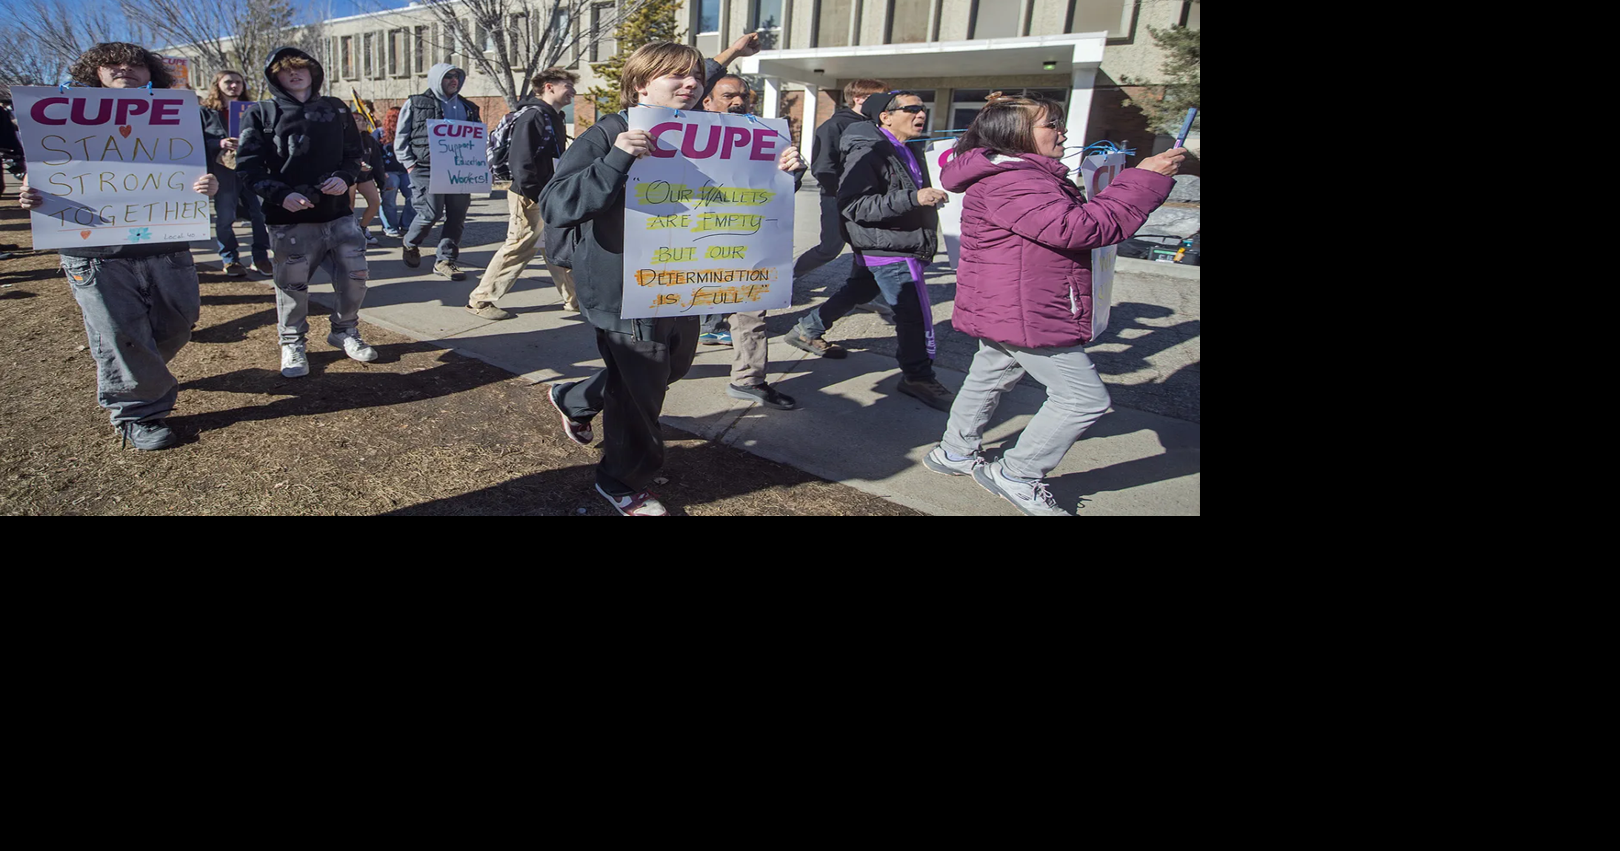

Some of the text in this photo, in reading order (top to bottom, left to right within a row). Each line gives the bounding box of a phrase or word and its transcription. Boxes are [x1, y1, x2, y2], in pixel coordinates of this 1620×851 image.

[30, 97, 184, 126] CUPE
[433, 124, 483, 139] CUPE
[648, 121, 778, 161] CUPE
[41, 135, 193, 166] STAND
[438, 139, 475, 158] Support
[49, 171, 185, 197] STRONG
[447, 170, 488, 184] Workers!
[694, 180, 768, 210] WALLETS
[650, 214, 691, 228] ARE
[658, 246, 744, 262] BUT OUR
[660, 293, 678, 305] IS
